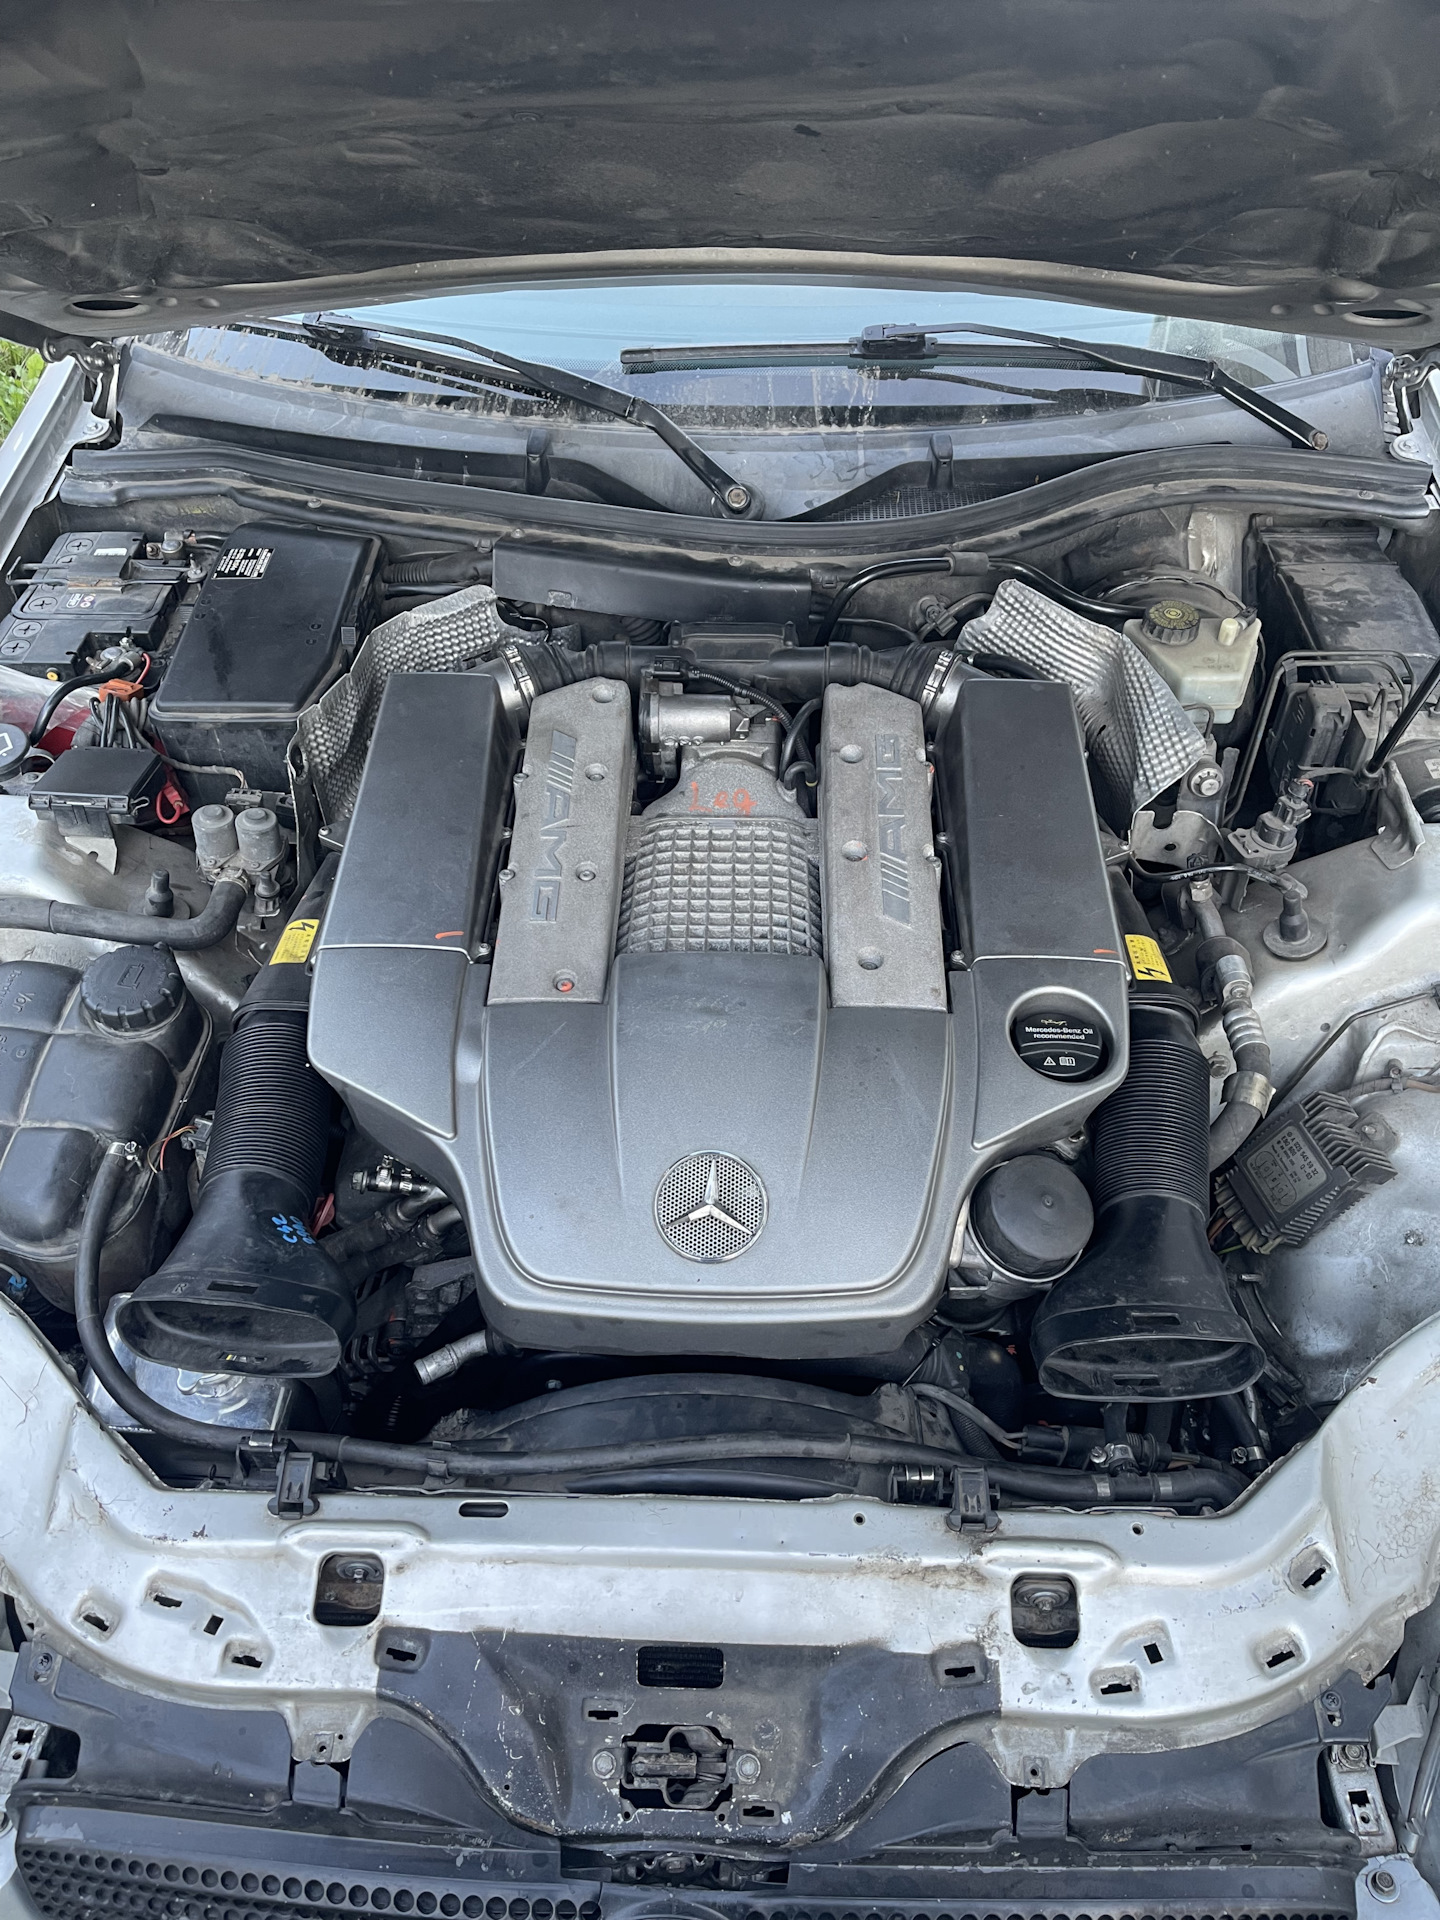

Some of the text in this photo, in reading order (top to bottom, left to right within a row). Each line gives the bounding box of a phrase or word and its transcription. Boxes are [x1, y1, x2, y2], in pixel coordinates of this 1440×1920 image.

[529, 782, 572, 924] AMG
[875, 734, 907, 863] AMG
[1025, 1026, 1082, 1034] Mercedes-Benz
